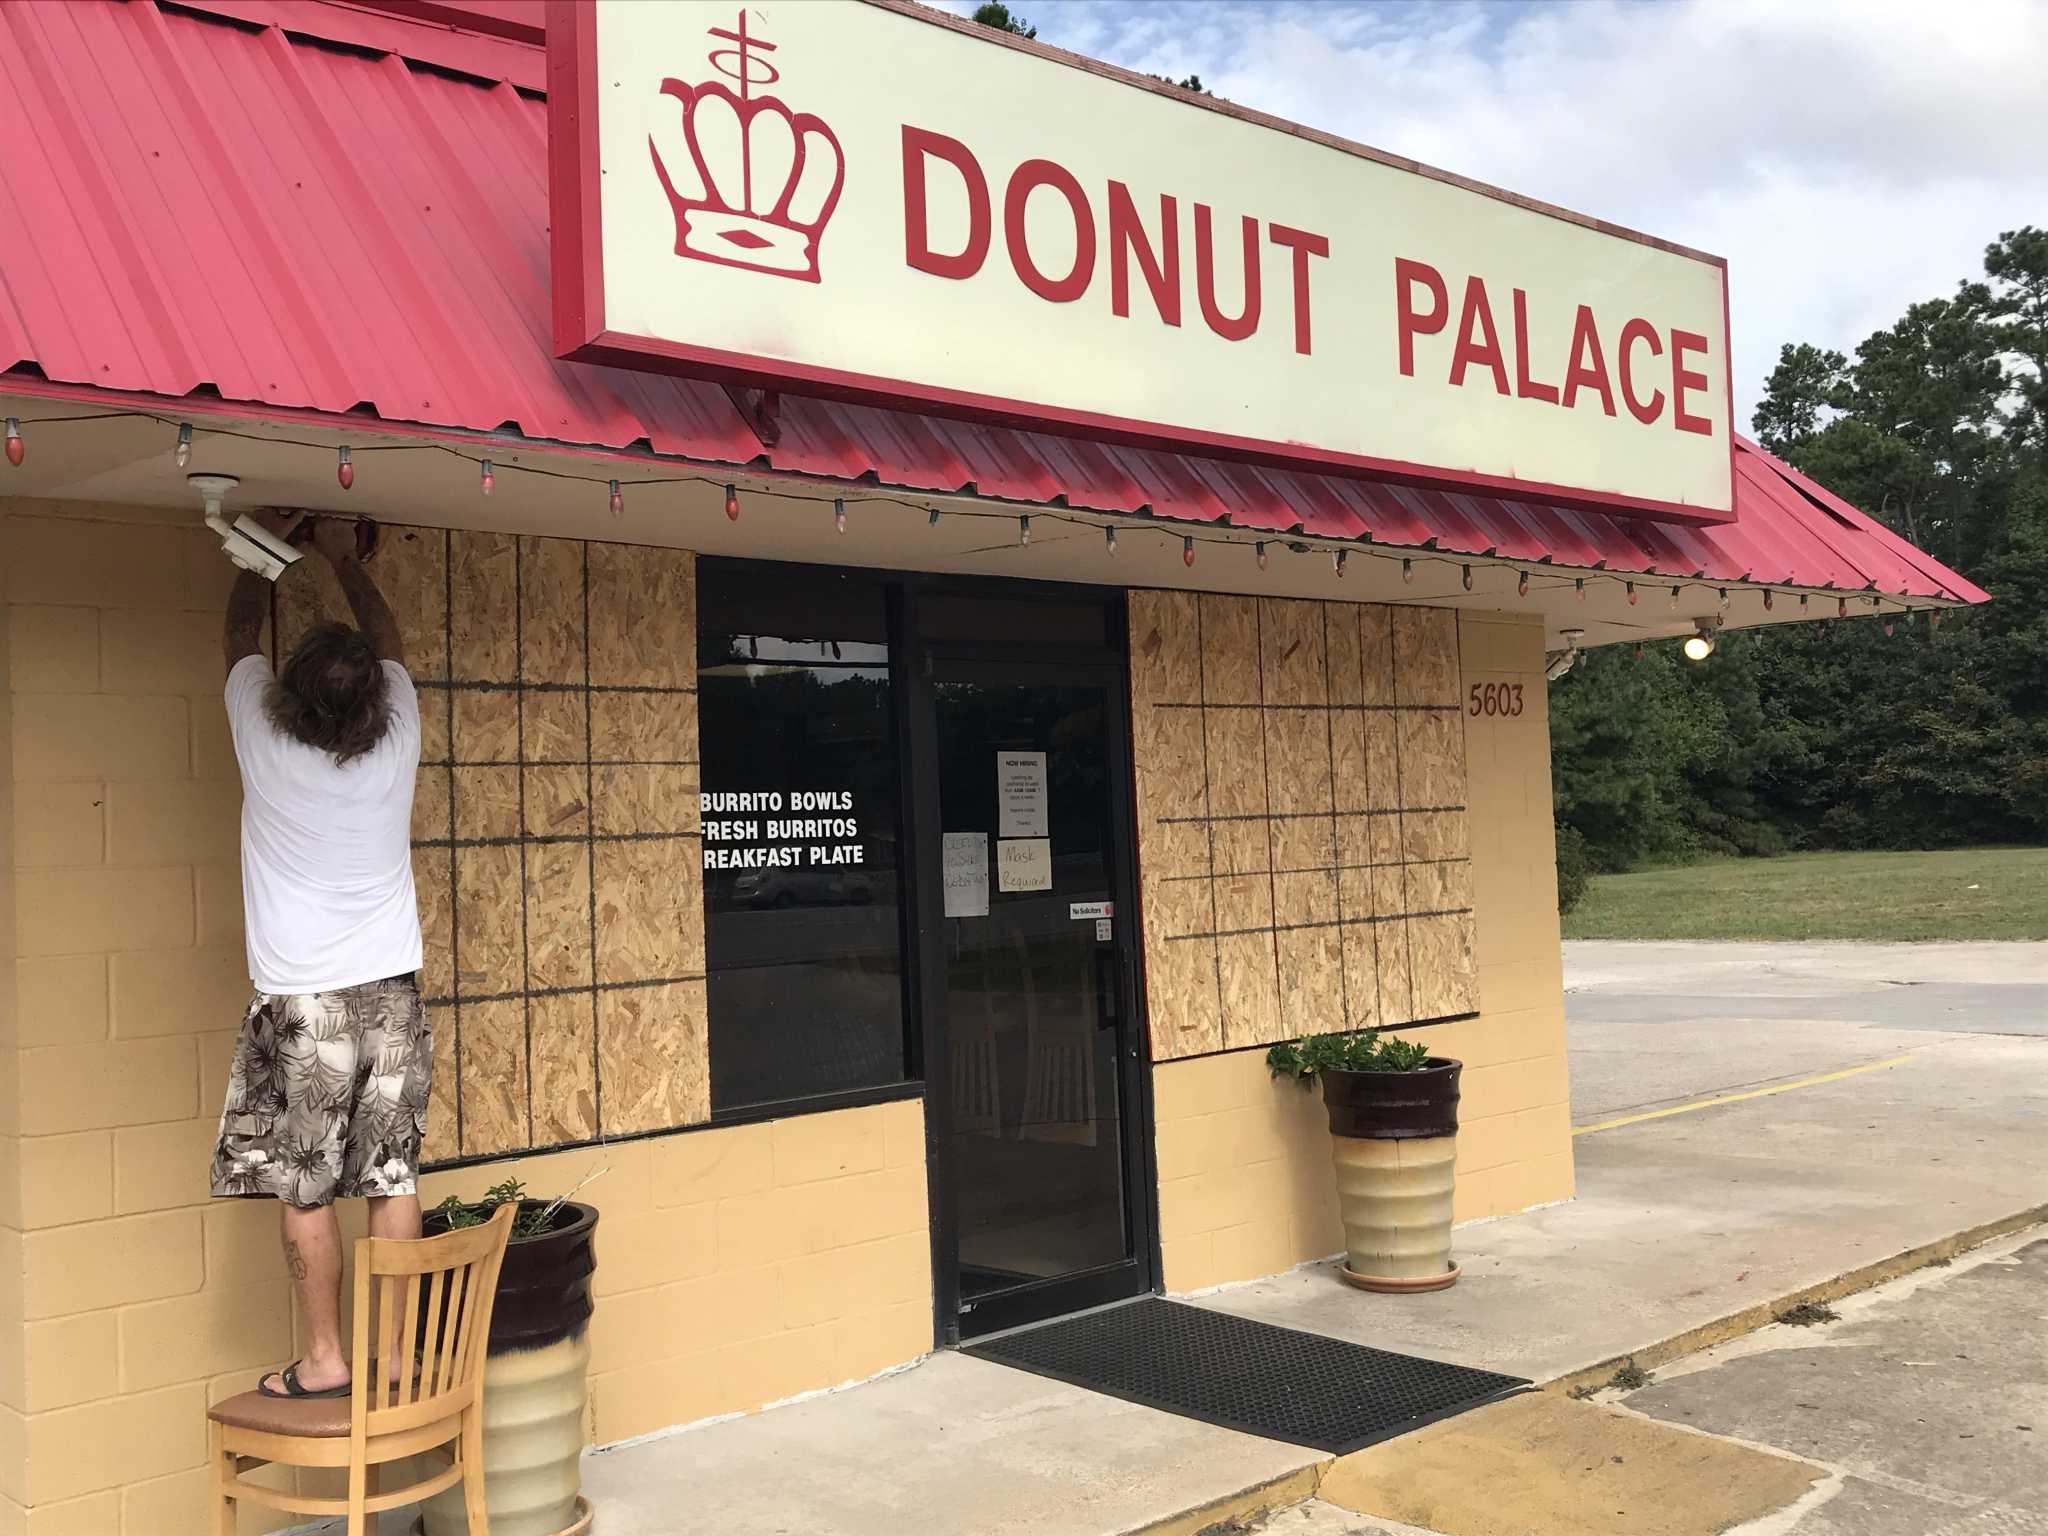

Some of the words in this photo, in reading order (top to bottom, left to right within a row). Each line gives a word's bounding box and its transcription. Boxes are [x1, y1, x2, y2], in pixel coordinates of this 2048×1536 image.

[902, 125, 1328, 355] DONUT
[1396, 258, 1712, 436] PALACE
[1470, 682, 1524, 717] 5603
[700, 792, 782, 812] BURRITO
[791, 791, 853, 811] BOWLS
[767, 818, 857, 839] BURRITOS
[704, 847, 802, 869] REAKFAST
[810, 845, 863, 865] PLATE
[1006, 846, 1036, 864] Mask
